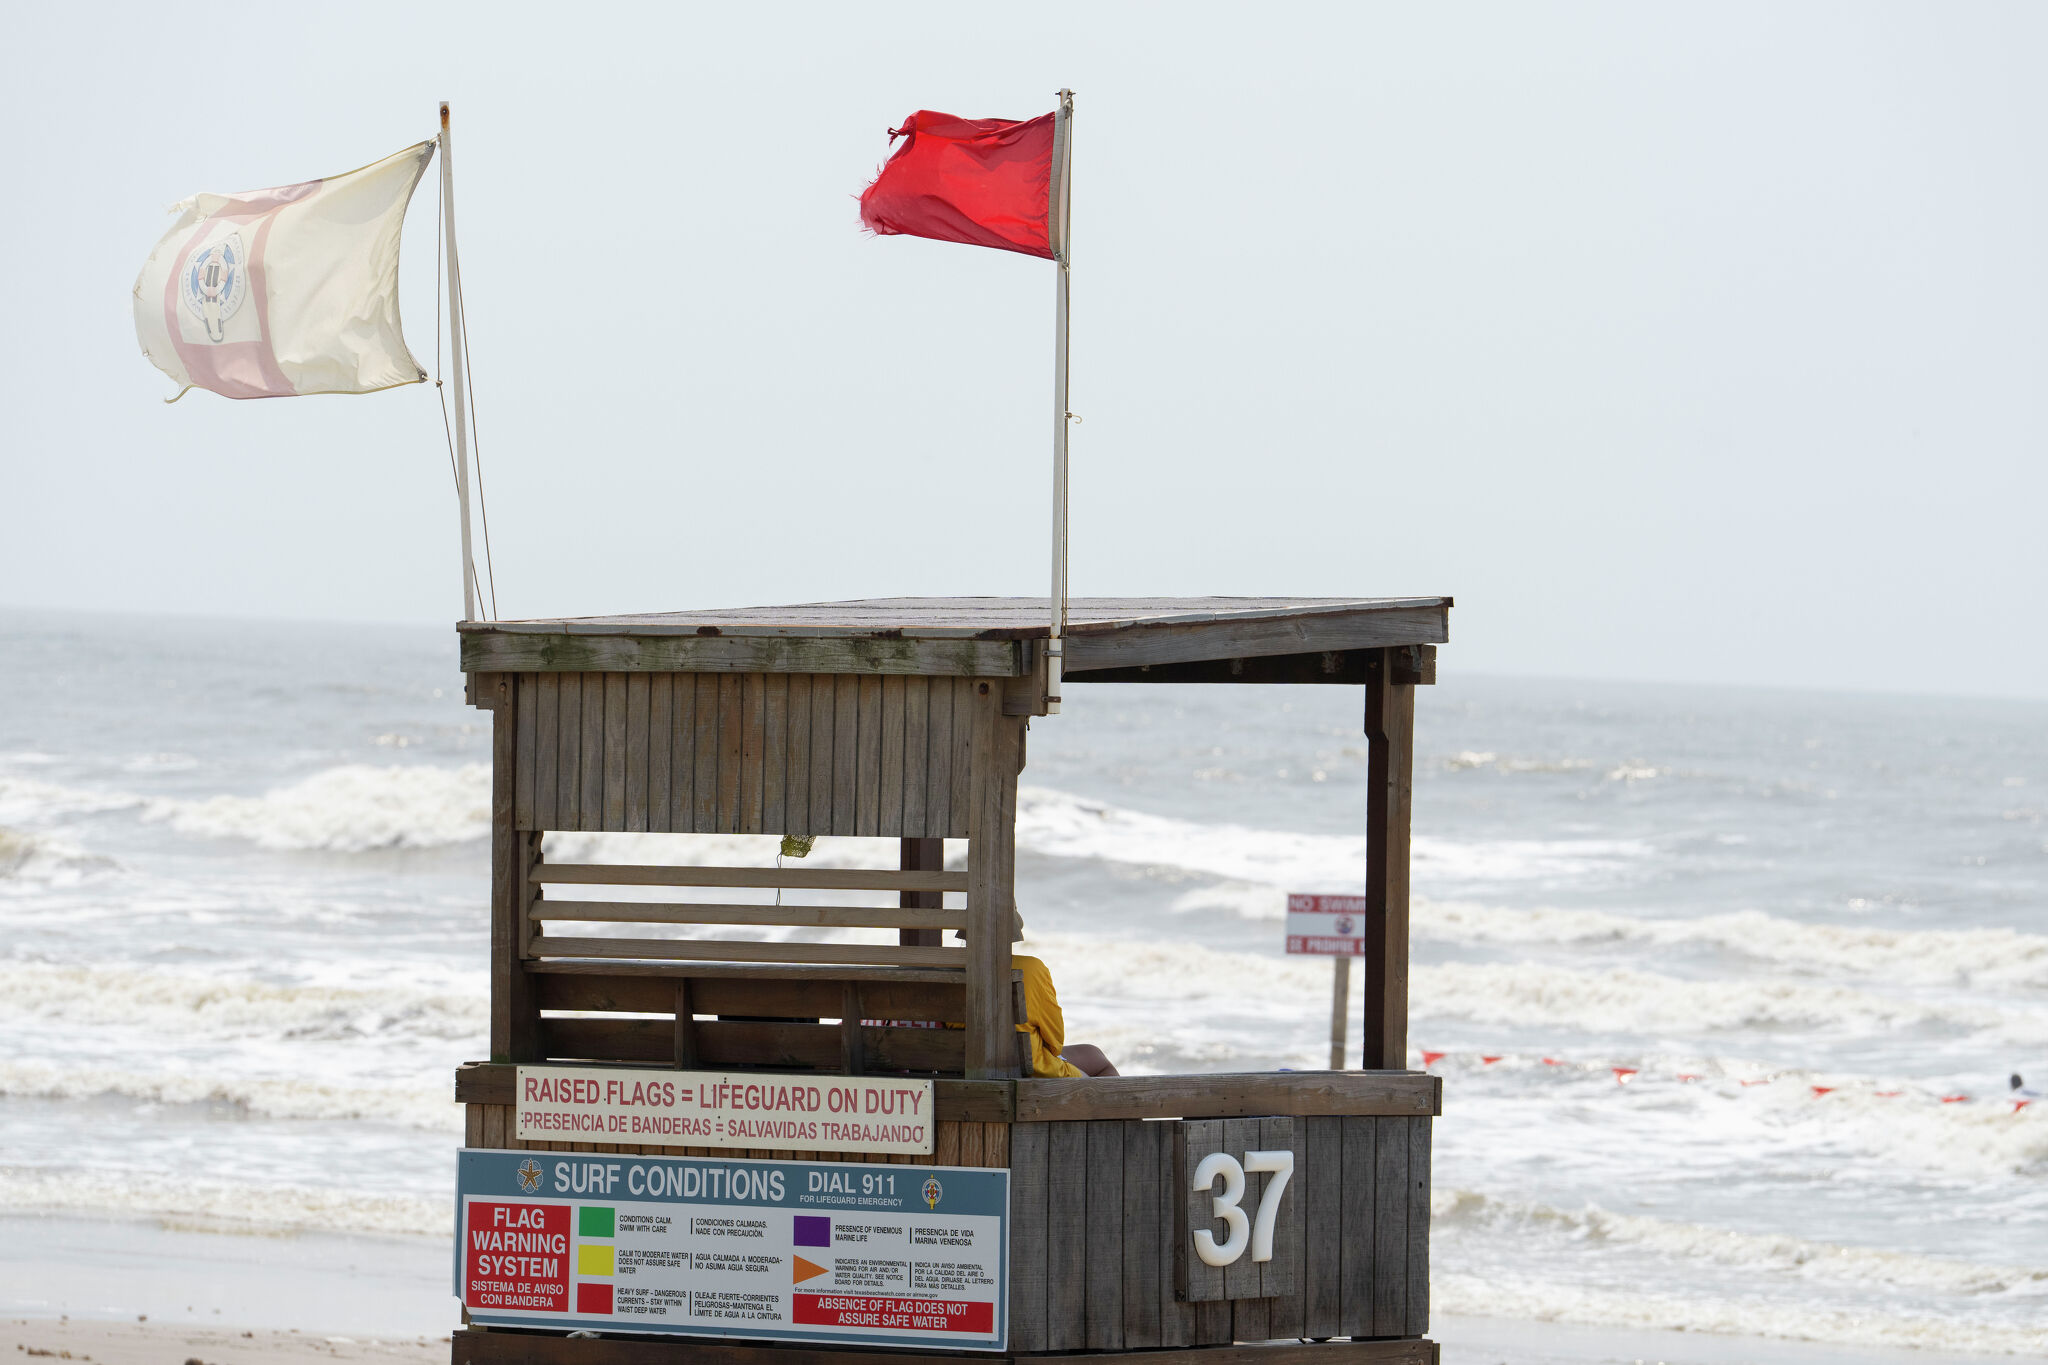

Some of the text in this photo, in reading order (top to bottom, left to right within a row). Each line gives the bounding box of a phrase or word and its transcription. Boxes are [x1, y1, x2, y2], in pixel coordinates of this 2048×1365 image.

[525, 1077, 923, 1115] RAISED FLAGS = LIFEGUARD ON DUTY
[524, 1111, 604, 1132] PRESENCIA
[608, 1115, 628, 1132] DE
[632, 1116, 711, 1136] BANDERAS
[728, 1119, 817, 1139] SALVAVIDAS
[822, 1122, 924, 1143] TRABAJANDO
[554, 1162, 785, 1201] SURF CONDITIONS
[808, 1171, 895, 1195] DIAL 911
[800, 1195, 903, 1206] FOR LIFEGUARD EMERGENCY
[1192, 1150, 1295, 1267] 37
[494, 1207, 545, 1229] FLAG
[619, 1215, 654, 1224] CONDITIONS
[695, 1218, 735, 1227] CONDICIONES
[619, 1223, 667, 1233] SWIM WITH CARE
[712, 1228, 726, 1236] CON
[835, 1225, 864, 1233] PRESENCE
[873, 1226, 903, 1235] VENEMOUS
[914, 1228, 948, 1237] PRESENCIA
[960, 1230, 974, 1238] VIDA
[472, 1230, 566, 1254] WARNING
[835, 1234, 856, 1242] MARINE
[914, 1237, 972, 1247] MARINA VENENOSA
[618, 1250, 689, 1260] CALM TO MODERATE WATER
[695, 1253, 711, 1261] AGUA
[712, 1253, 740, 1262] CALMADA
[478, 1254, 558, 1278] SYSTEM
[618, 1258, 681, 1268] DOES NOT ASSURE SAFE
[694, 1262, 769, 1273] NO ASUMA AGUA SEGURA
[868, 1259, 908, 1268] ENVIRONMENTAL
[940, 1262, 956, 1270] AVISO
[956, 1263, 983, 1271] AMBIENTAL
[618, 1266, 636, 1274] WATER
[934, 1269, 956, 1277] CALIDAD
[967, 1270, 979, 1278] AIRE
[874, 1273, 885, 1281] SEE
[471, 1280, 564, 1295] SISTEMA DE AVISO
[617, 1287, 635, 1296] HEAVY
[635, 1288, 650, 1297] SURF
[654, 1289, 687, 1298] DANGEROUS
[480, 1293, 554, 1308] CON BANDERA
[694, 1291, 717, 1300] OLEAJE
[617, 1296, 646, 1305] CURRENTS
[650, 1298, 663, 1306] STAY
[663, 1299, 683, 1307] WITHIN
[817, 1297, 969, 1316] ABSENCE OF FLAG DOES NOT
[617, 1305, 667, 1315] WAIST DEEP WATER
[765, 1303, 774, 1312] EL
[714, 1310, 723, 1318] DE
[724, 1310, 740, 1319] AGUA
[741, 1311, 747, 1319] A
[747, 1311, 756, 1320] LA
[756, 1312, 783, 1321] CINTURA
[838, 1312, 948, 1329] ASSURE SAFE WATER
